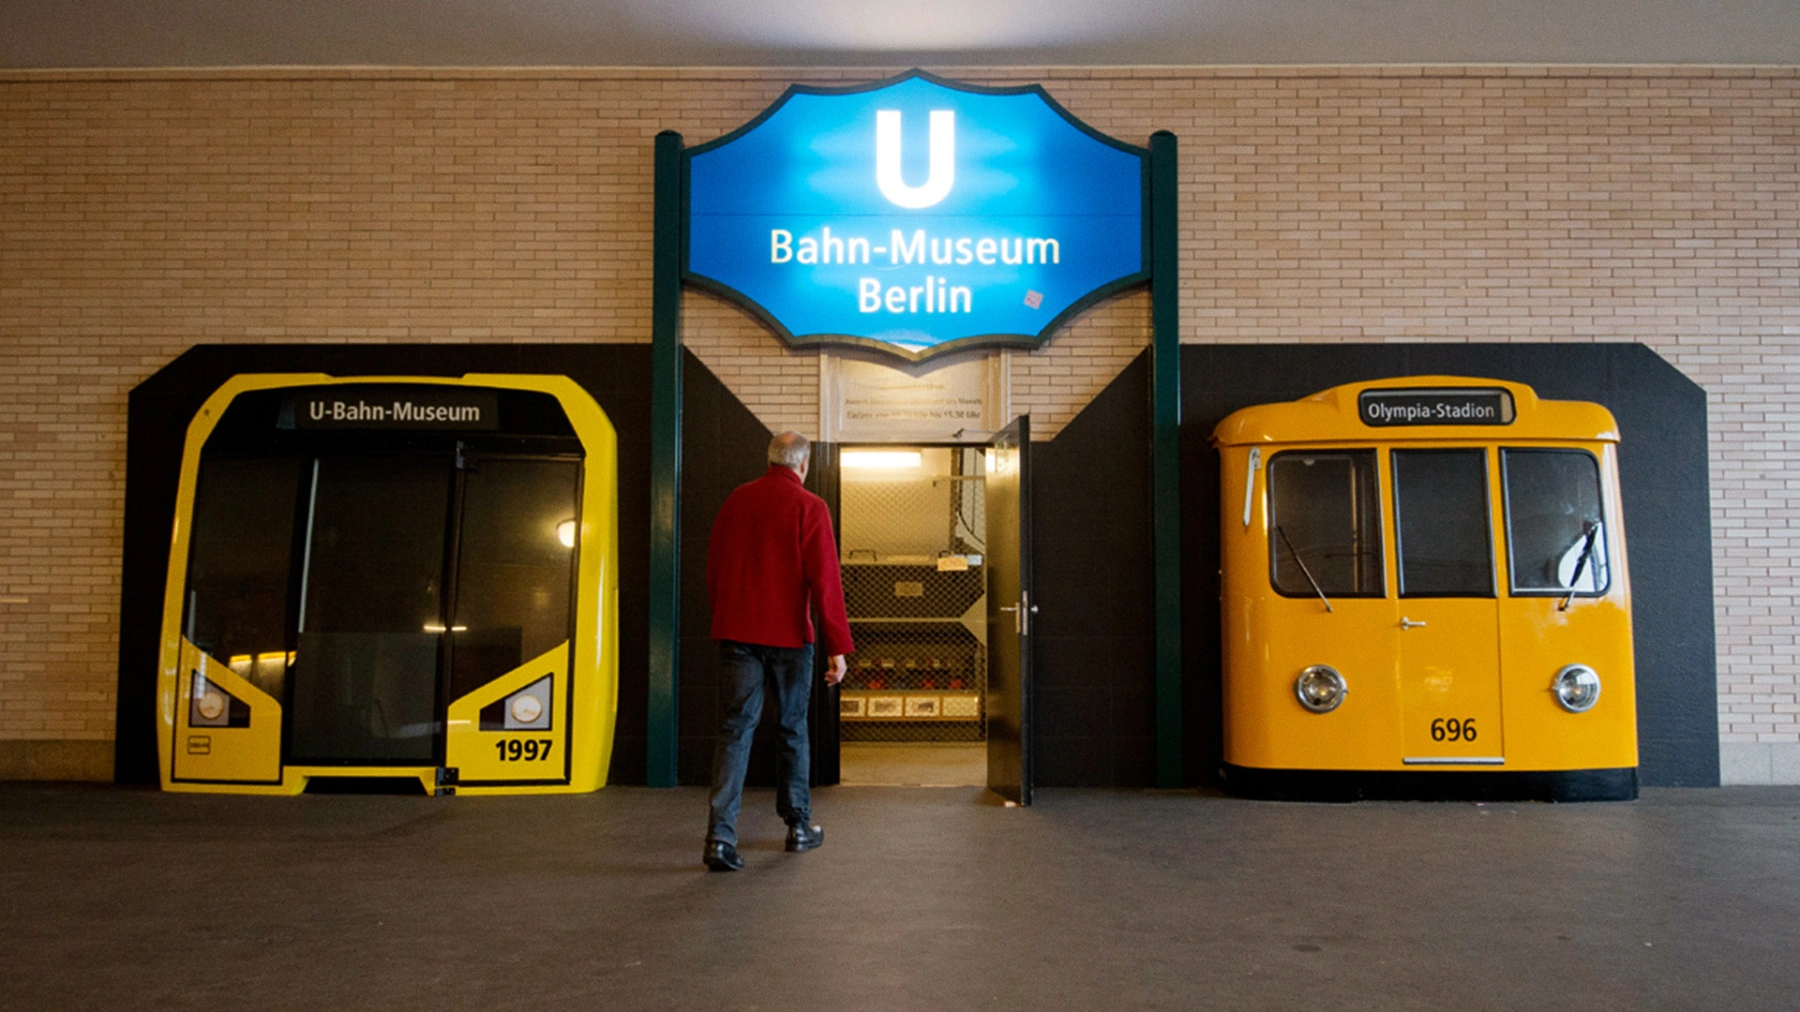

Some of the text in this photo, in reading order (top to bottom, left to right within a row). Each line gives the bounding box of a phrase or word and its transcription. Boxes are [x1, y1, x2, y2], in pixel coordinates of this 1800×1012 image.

[875, 109, 955, 209] U
[770, 226, 1060, 265] Bahn-Museum
[858, 275, 972, 313] Berlin
[309, 400, 481, 421] U-Bahn-Museum
[1368, 402, 1495, 421] Olympia-Stadion
[1431, 717, 1478, 742] 696
[495, 739, 553, 762] 1997
